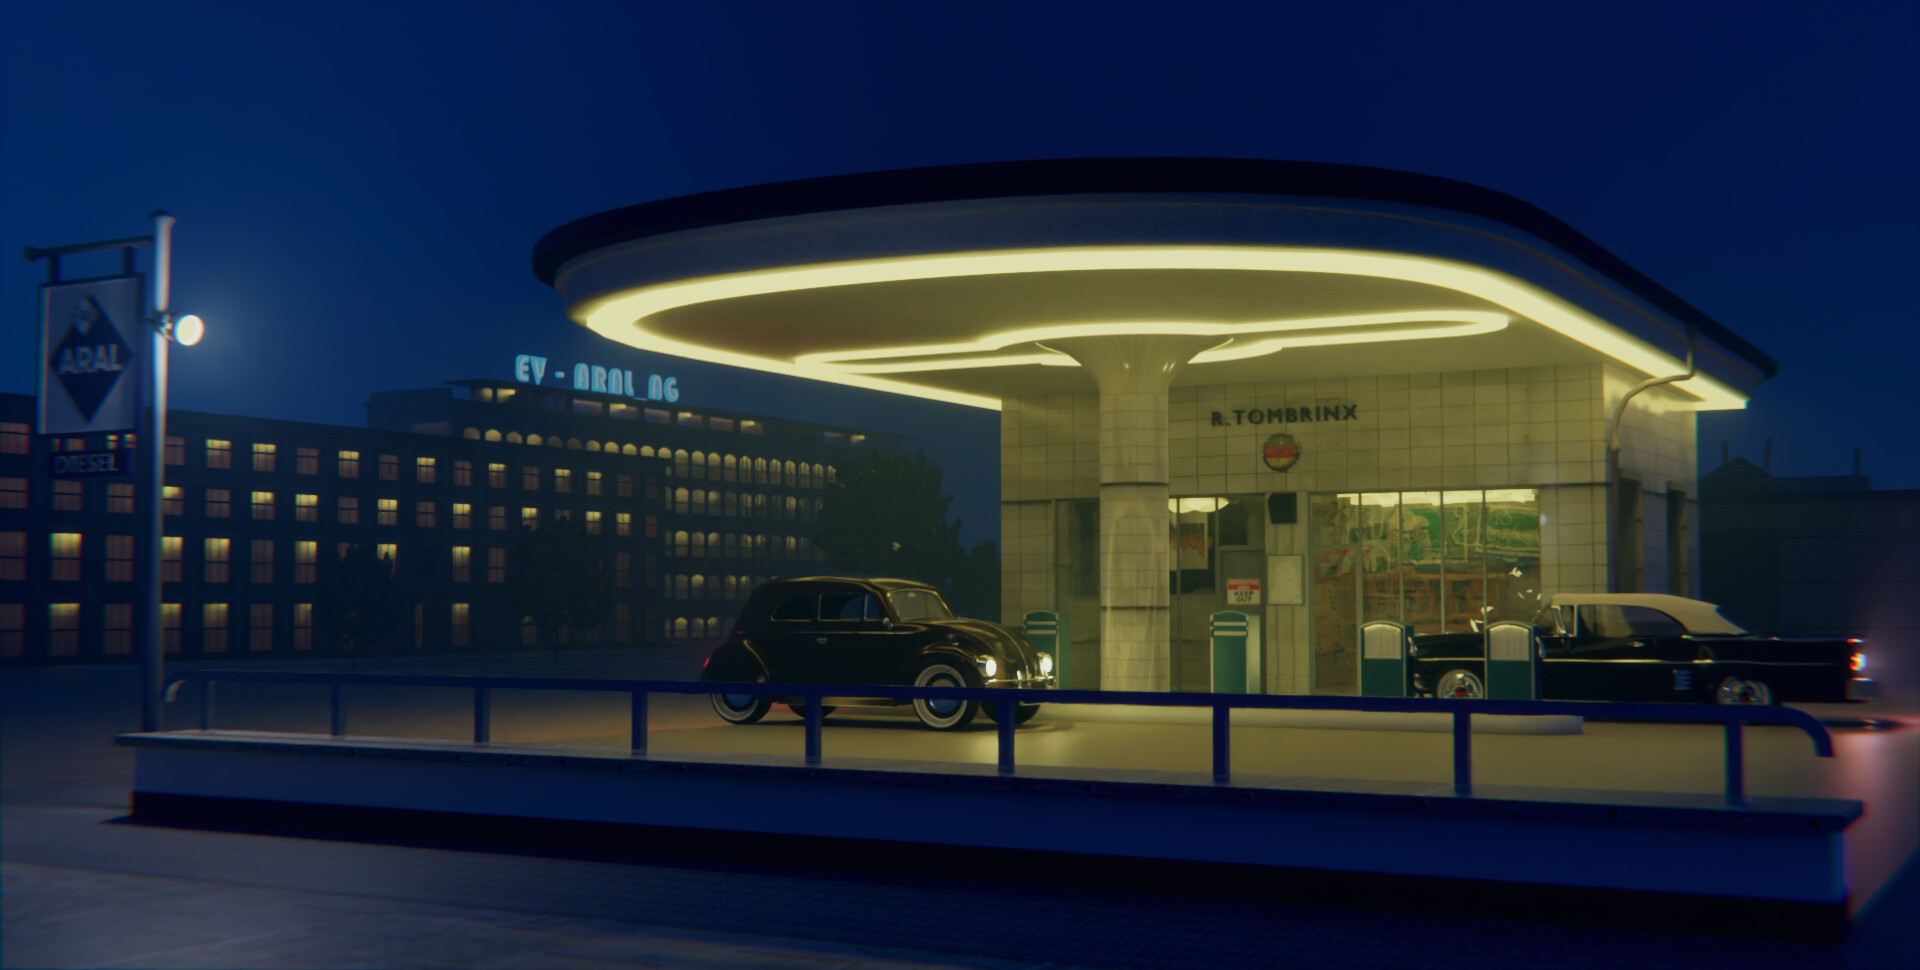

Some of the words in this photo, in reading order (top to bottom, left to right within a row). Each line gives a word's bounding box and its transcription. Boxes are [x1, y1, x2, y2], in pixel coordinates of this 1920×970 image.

[57, 343, 124, 375] ARAL
[515, 354, 548, 386] EV
[54, 453, 119, 474] DIESEL
